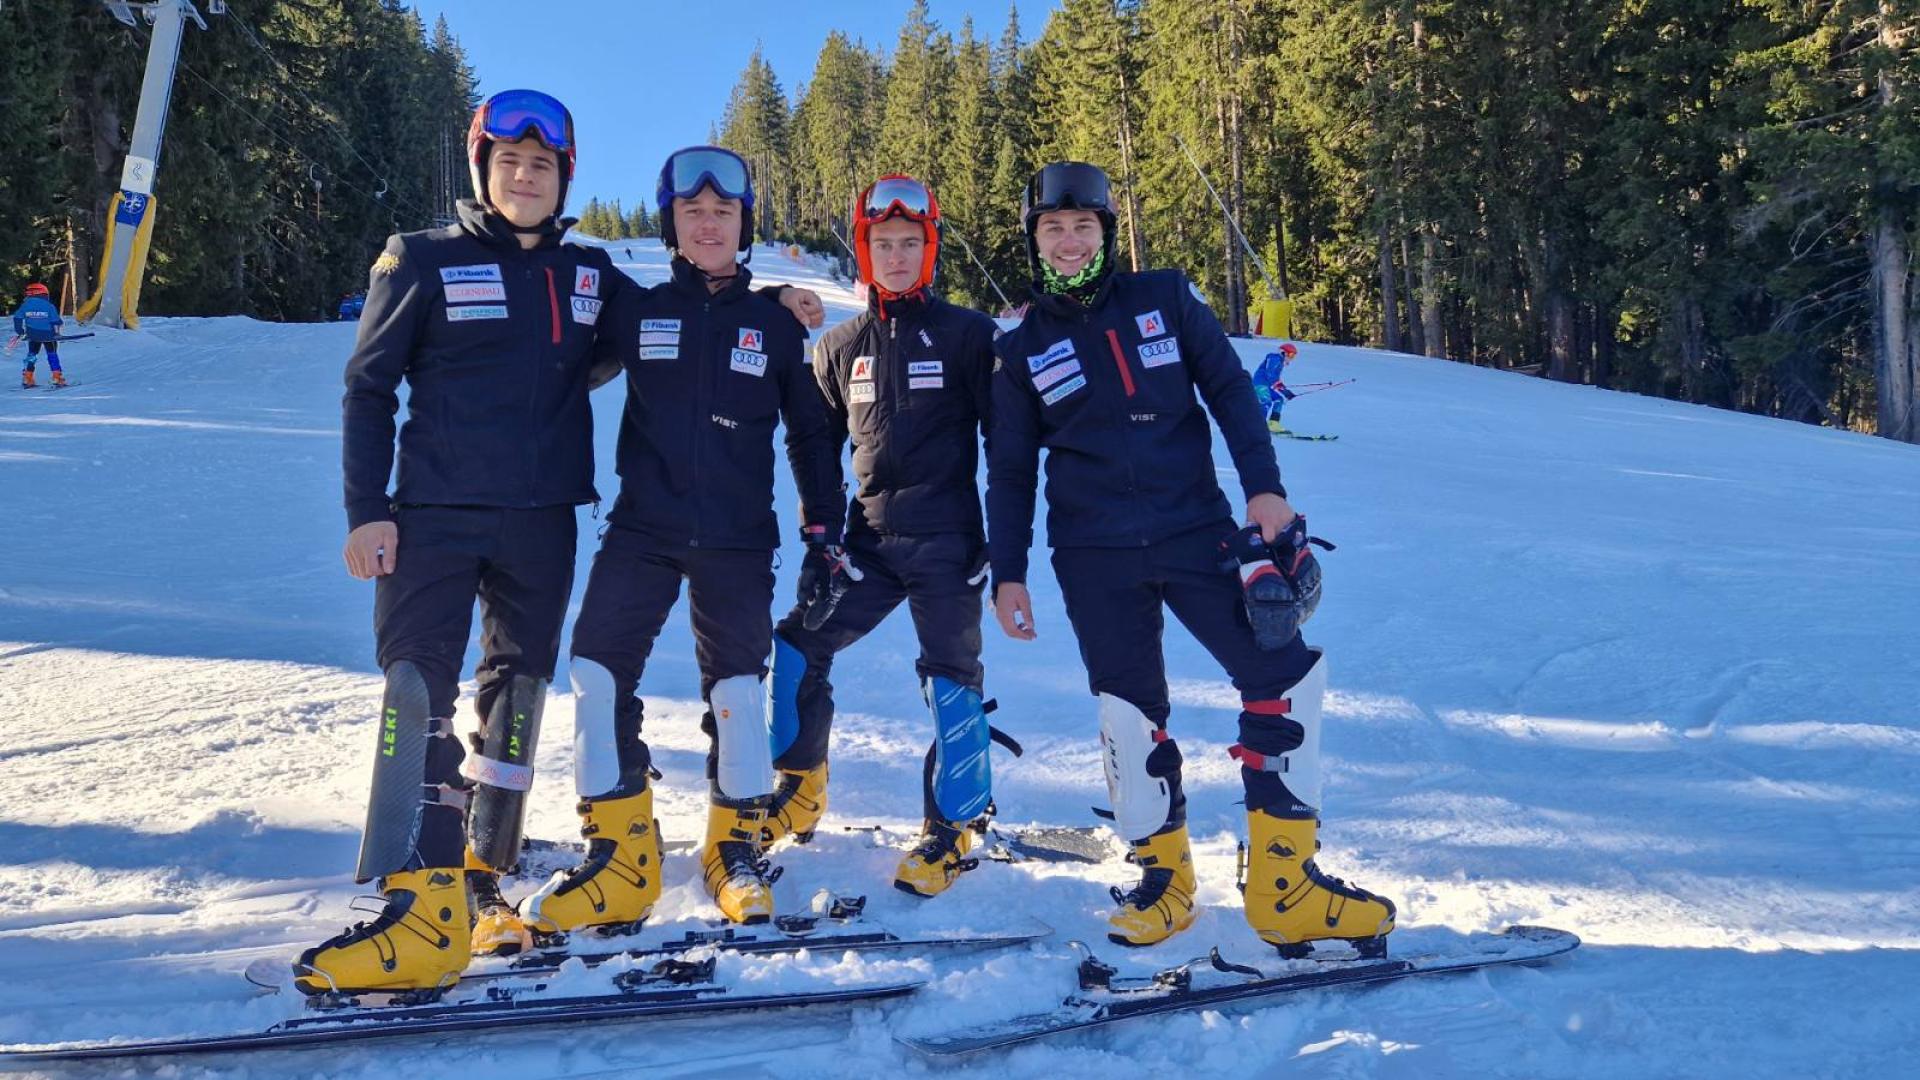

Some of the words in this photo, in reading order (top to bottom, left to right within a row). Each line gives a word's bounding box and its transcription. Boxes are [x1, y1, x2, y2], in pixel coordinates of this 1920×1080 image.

[457, 268, 494, 277] Fibank
[581, 272, 596, 289] A1
[1146, 315, 1158, 333] A1
[742, 331, 760, 348] A1
[855, 359, 870, 376] A1
[383, 707, 398, 757] LEKI
